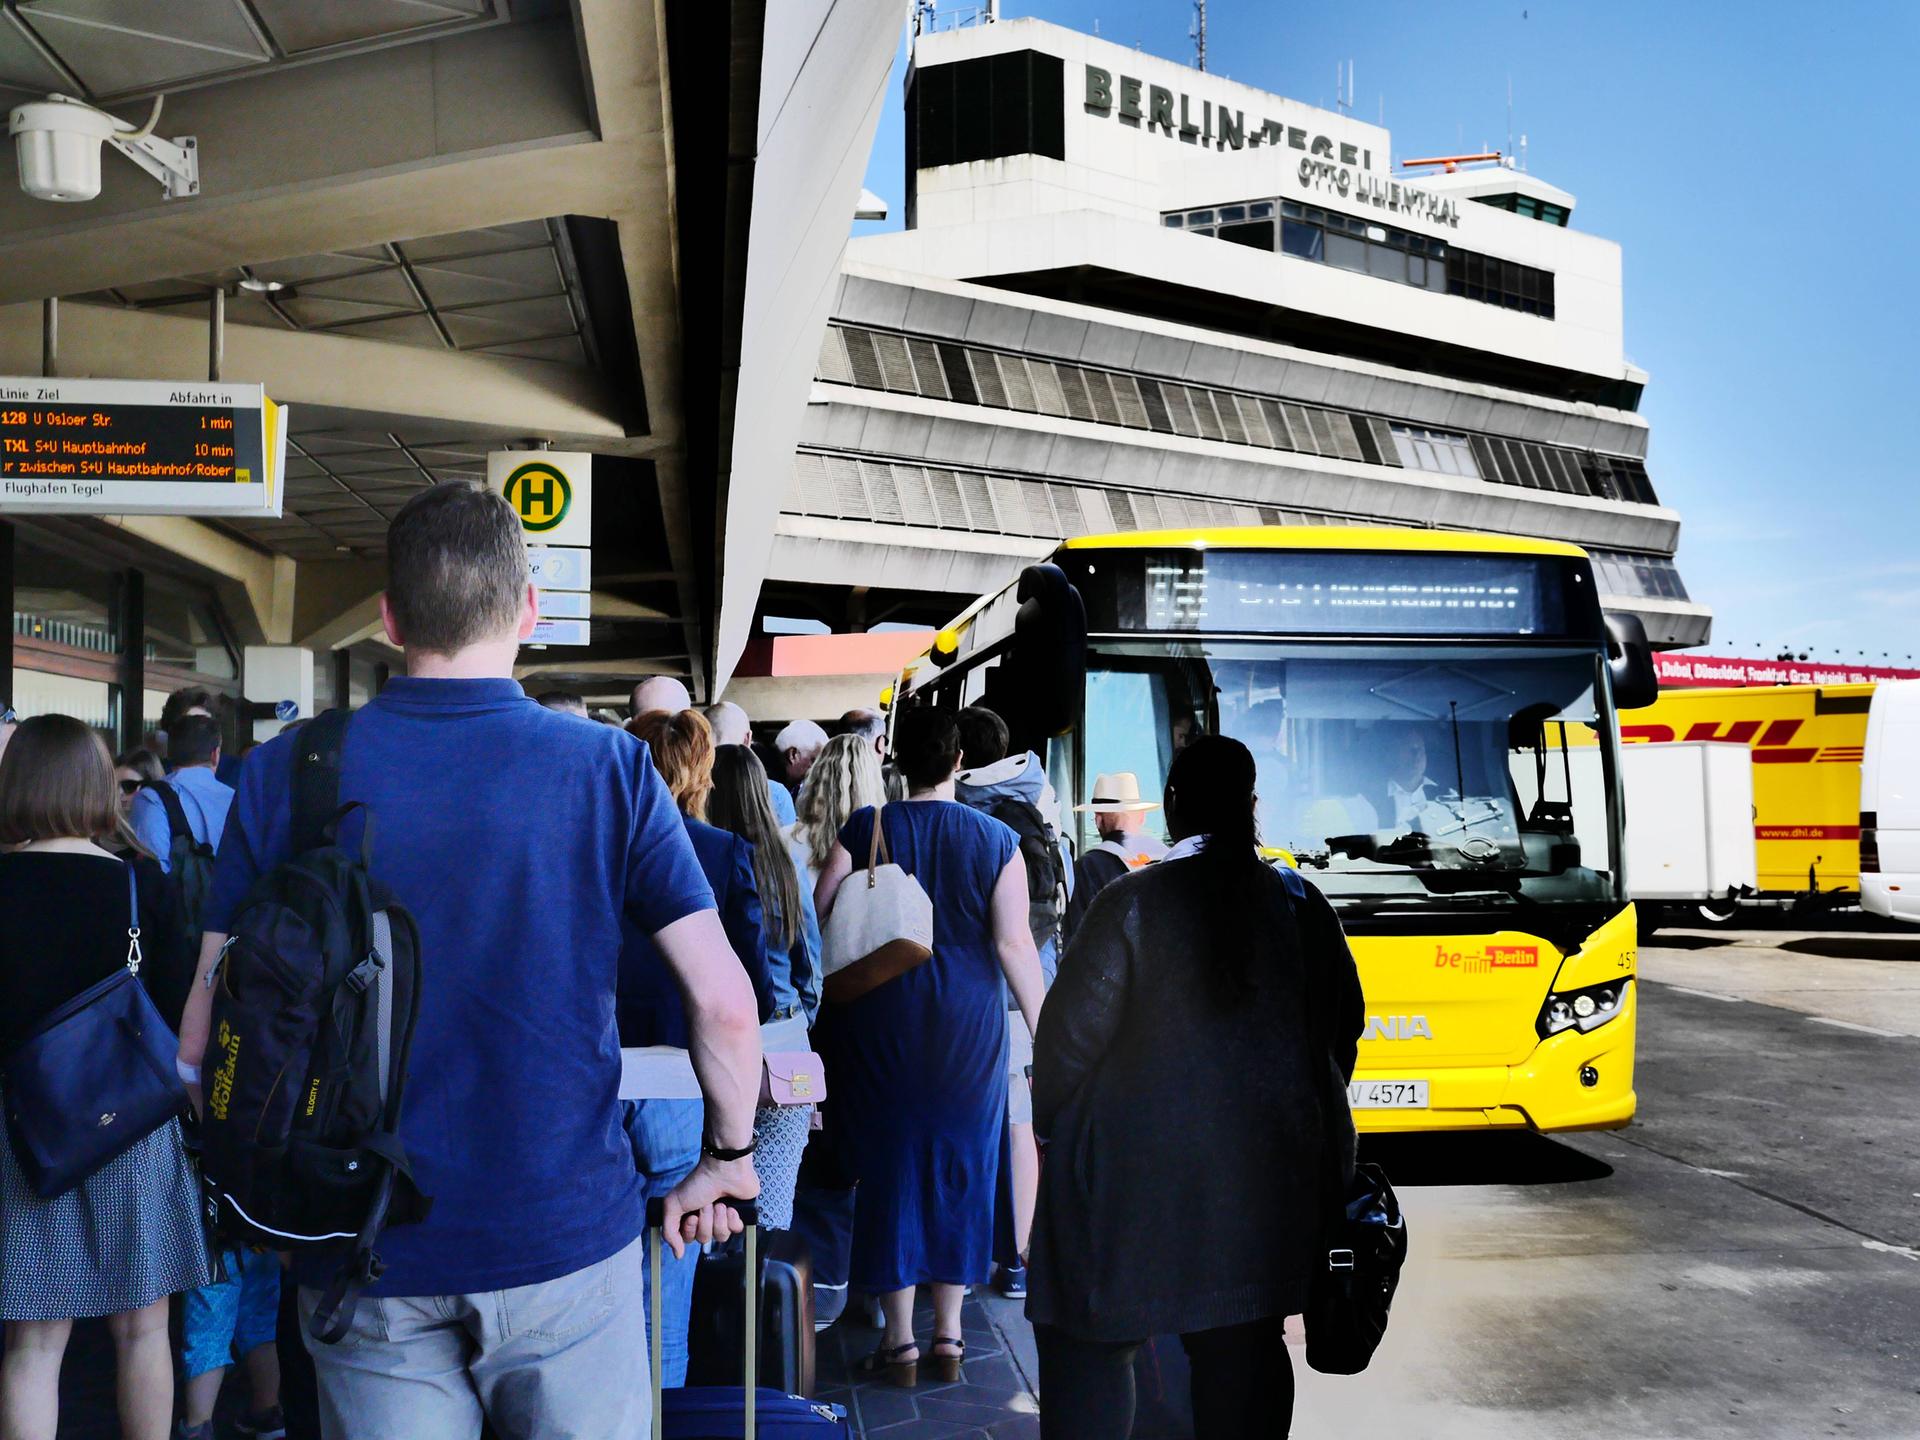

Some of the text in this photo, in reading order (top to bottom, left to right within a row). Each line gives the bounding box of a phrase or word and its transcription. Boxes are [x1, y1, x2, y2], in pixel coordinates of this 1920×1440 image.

[1299, 157, 1460, 228] OTTO LILIENTHAL
[0, 387, 60, 400] Linie Ziel
[169, 392, 232, 404] Abfahrt in
[1, 412, 113, 427] 128 U Osloer Str.
[201, 416, 233, 429] 1 min
[4, 439, 147, 455] TXL S+U Hauptbahnhof
[194, 443, 234, 457] 10 min
[19, 460, 76, 473] zwischen
[80, 461, 103, 474] S+U
[107, 461, 233, 476] Hauptbahnhof/Rober
[5, 482, 104, 497] Flughafen Tegel
[521, 479, 553, 515] H
[1761, 828, 1824, 838] www.dhl.de
[1434, 945, 1535, 968] be Berlin
[1361, 1015, 1433, 1041] NIA
[217, 1035, 241, 1120] Wolfskin
[305, 1087, 319, 1116] VELOCITY
[1369, 1085, 1418, 1104] 4571
